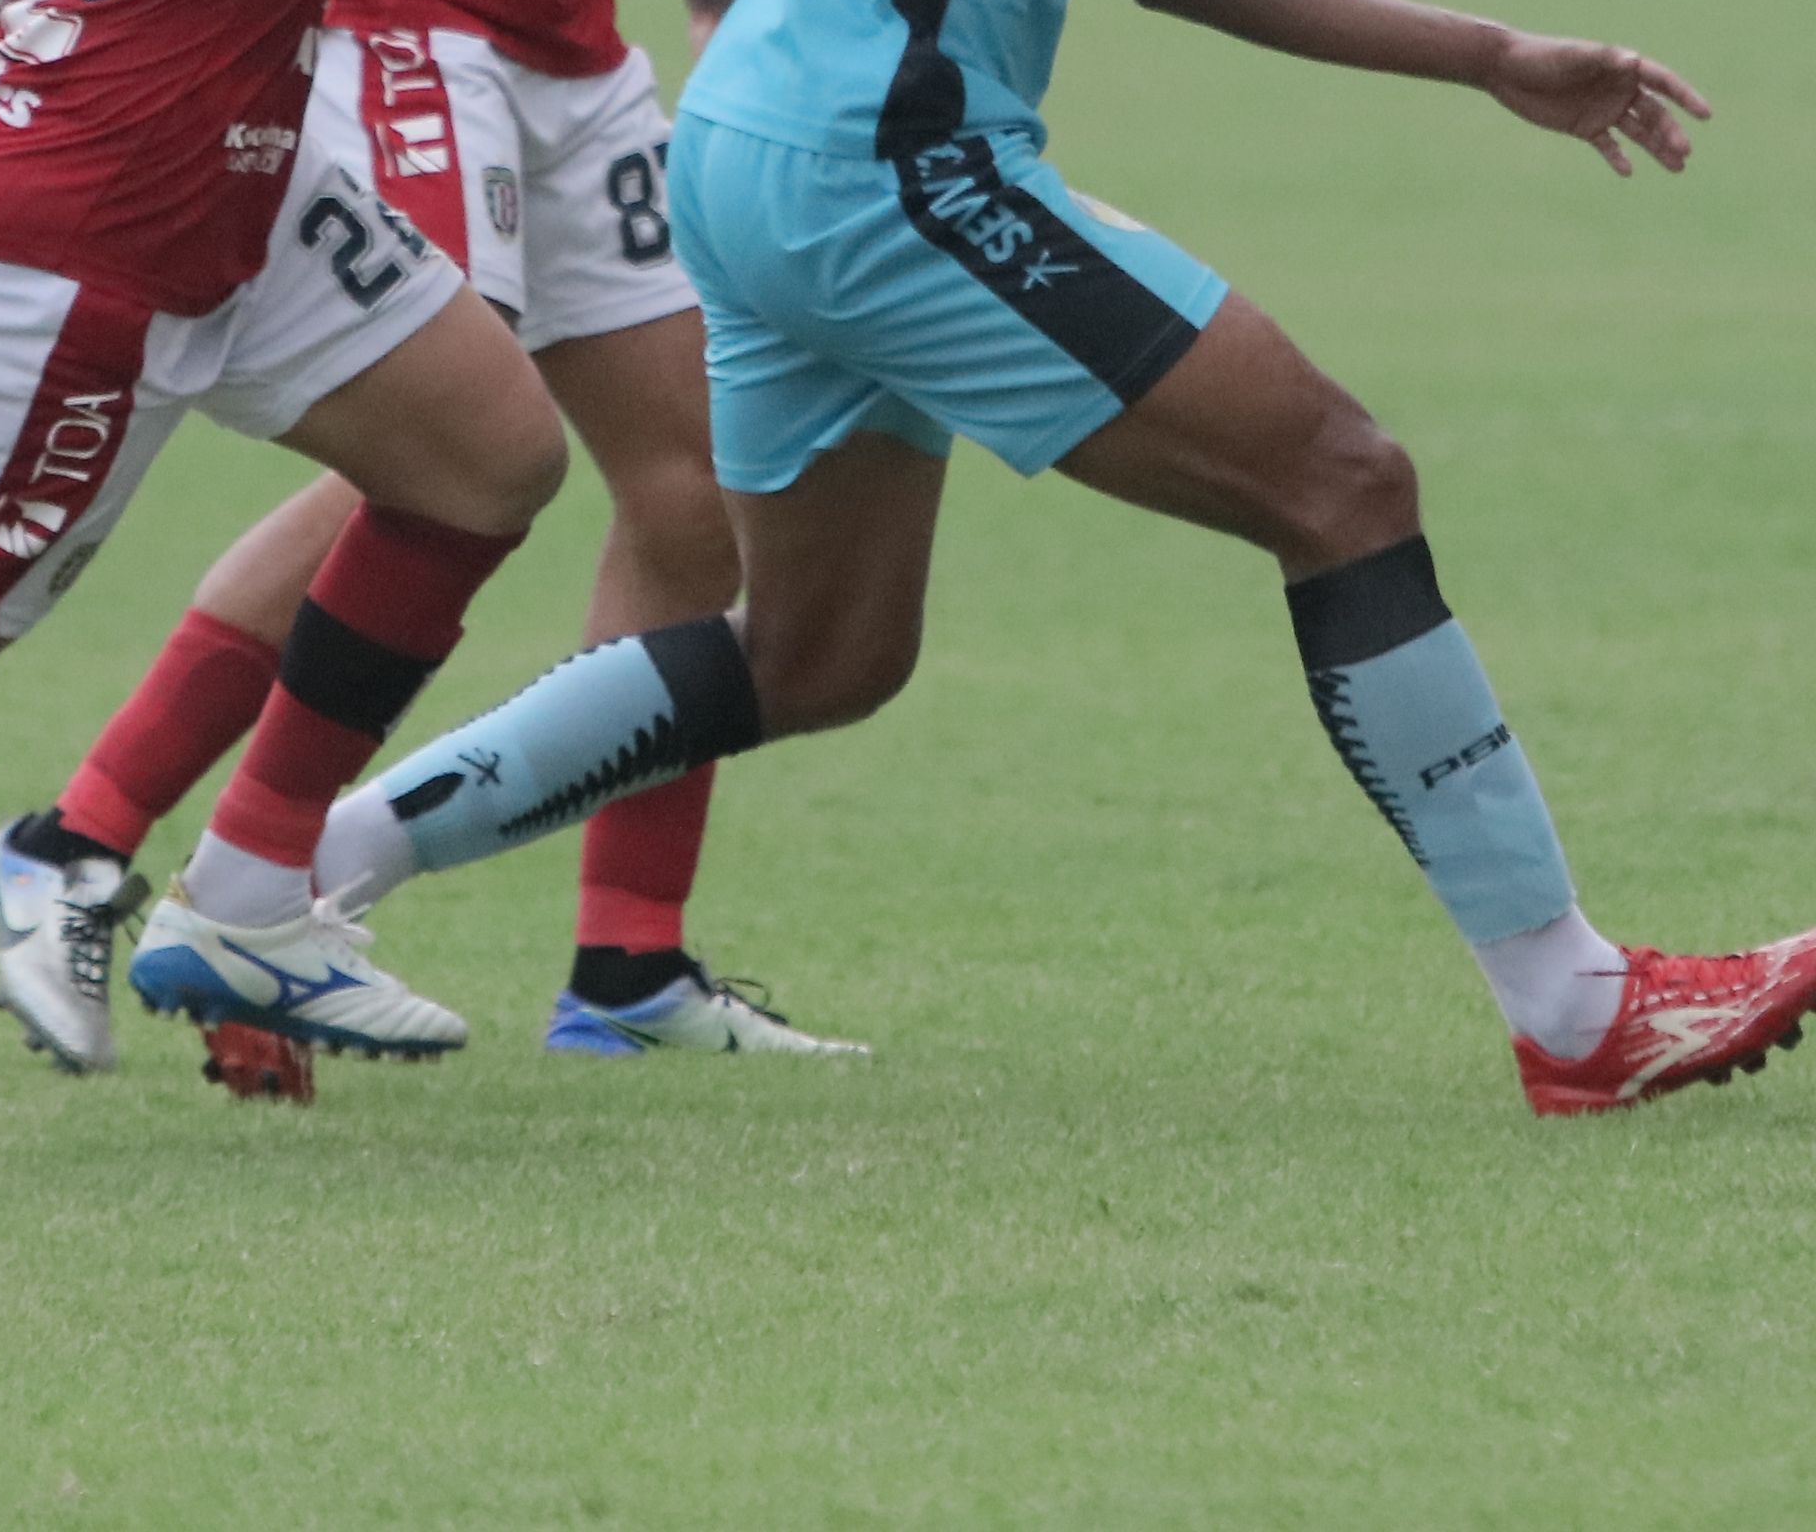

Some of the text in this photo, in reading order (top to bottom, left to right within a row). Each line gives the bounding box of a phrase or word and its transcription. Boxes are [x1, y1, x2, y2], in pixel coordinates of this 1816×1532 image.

[368, 28, 438, 107] TO
[606, 142, 670, 266] 8
[28, 390, 122, 484] TOA
[1418, 723, 1512, 790] PS
